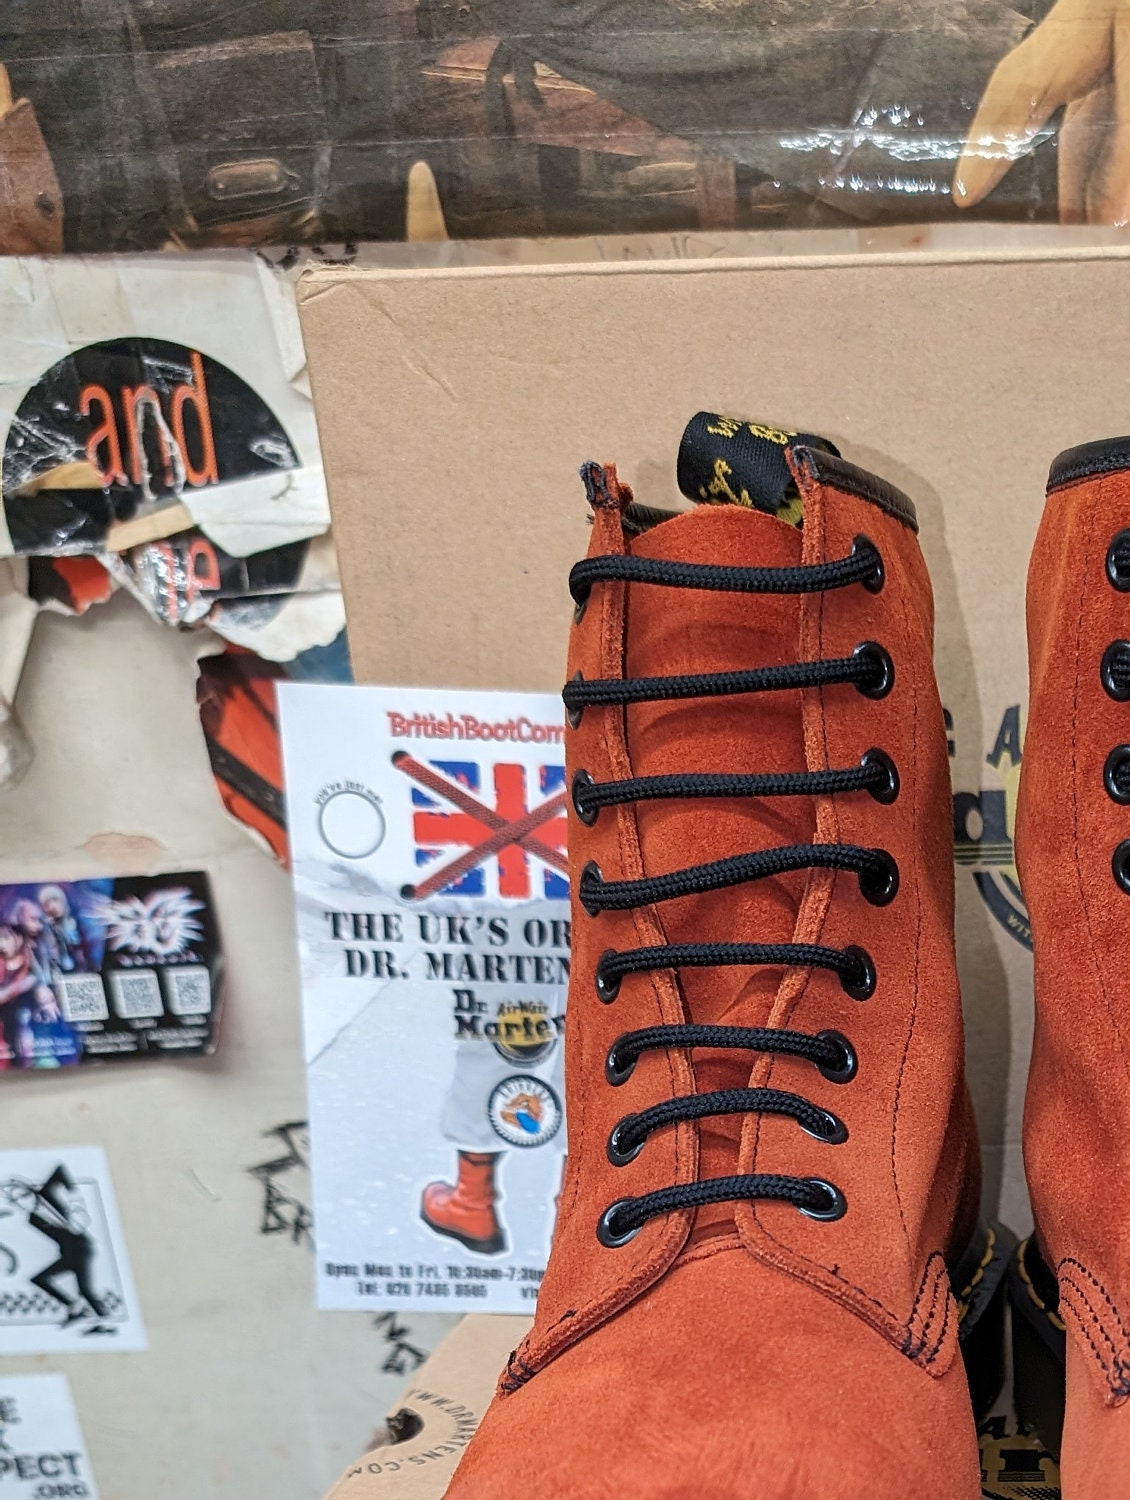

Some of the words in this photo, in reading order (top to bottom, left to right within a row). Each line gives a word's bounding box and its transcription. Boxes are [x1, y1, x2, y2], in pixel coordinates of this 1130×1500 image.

[78, 350, 219, 487] and
[325, 911, 403, 943] THE
[418, 915, 509, 946] UK'S
[344, 949, 409, 980] DR.
